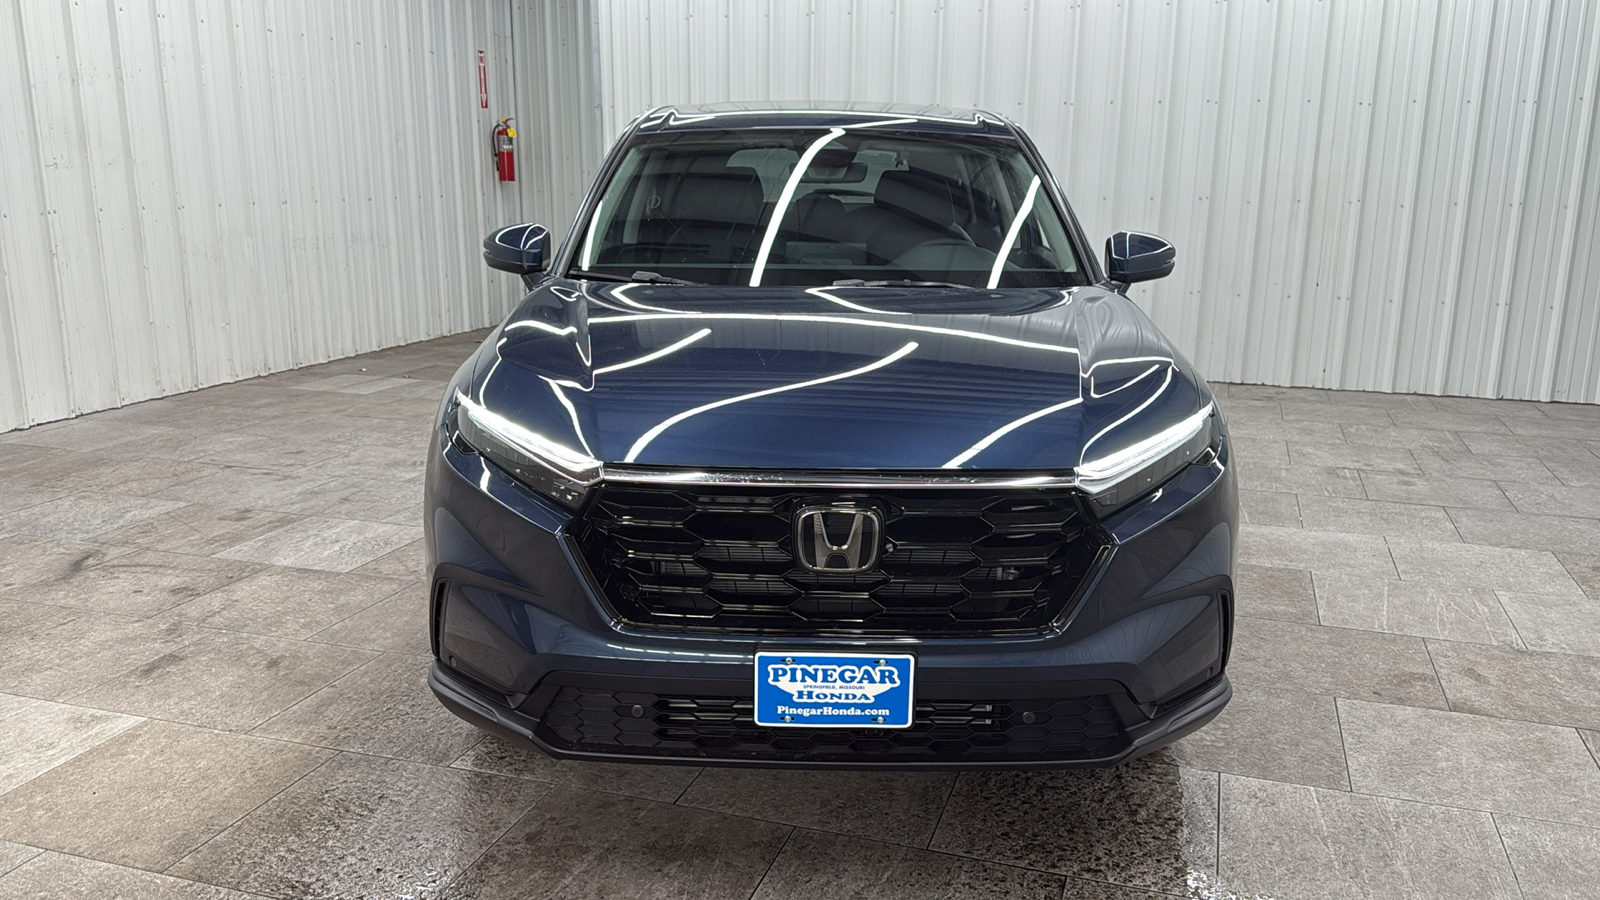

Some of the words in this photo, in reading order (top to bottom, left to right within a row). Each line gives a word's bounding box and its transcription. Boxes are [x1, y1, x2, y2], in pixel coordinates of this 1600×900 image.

[770, 666, 898, 685] PINEGAR
[796, 690, 872, 701] HONDA
[776, 705, 890, 717] PinegarHonda.com
